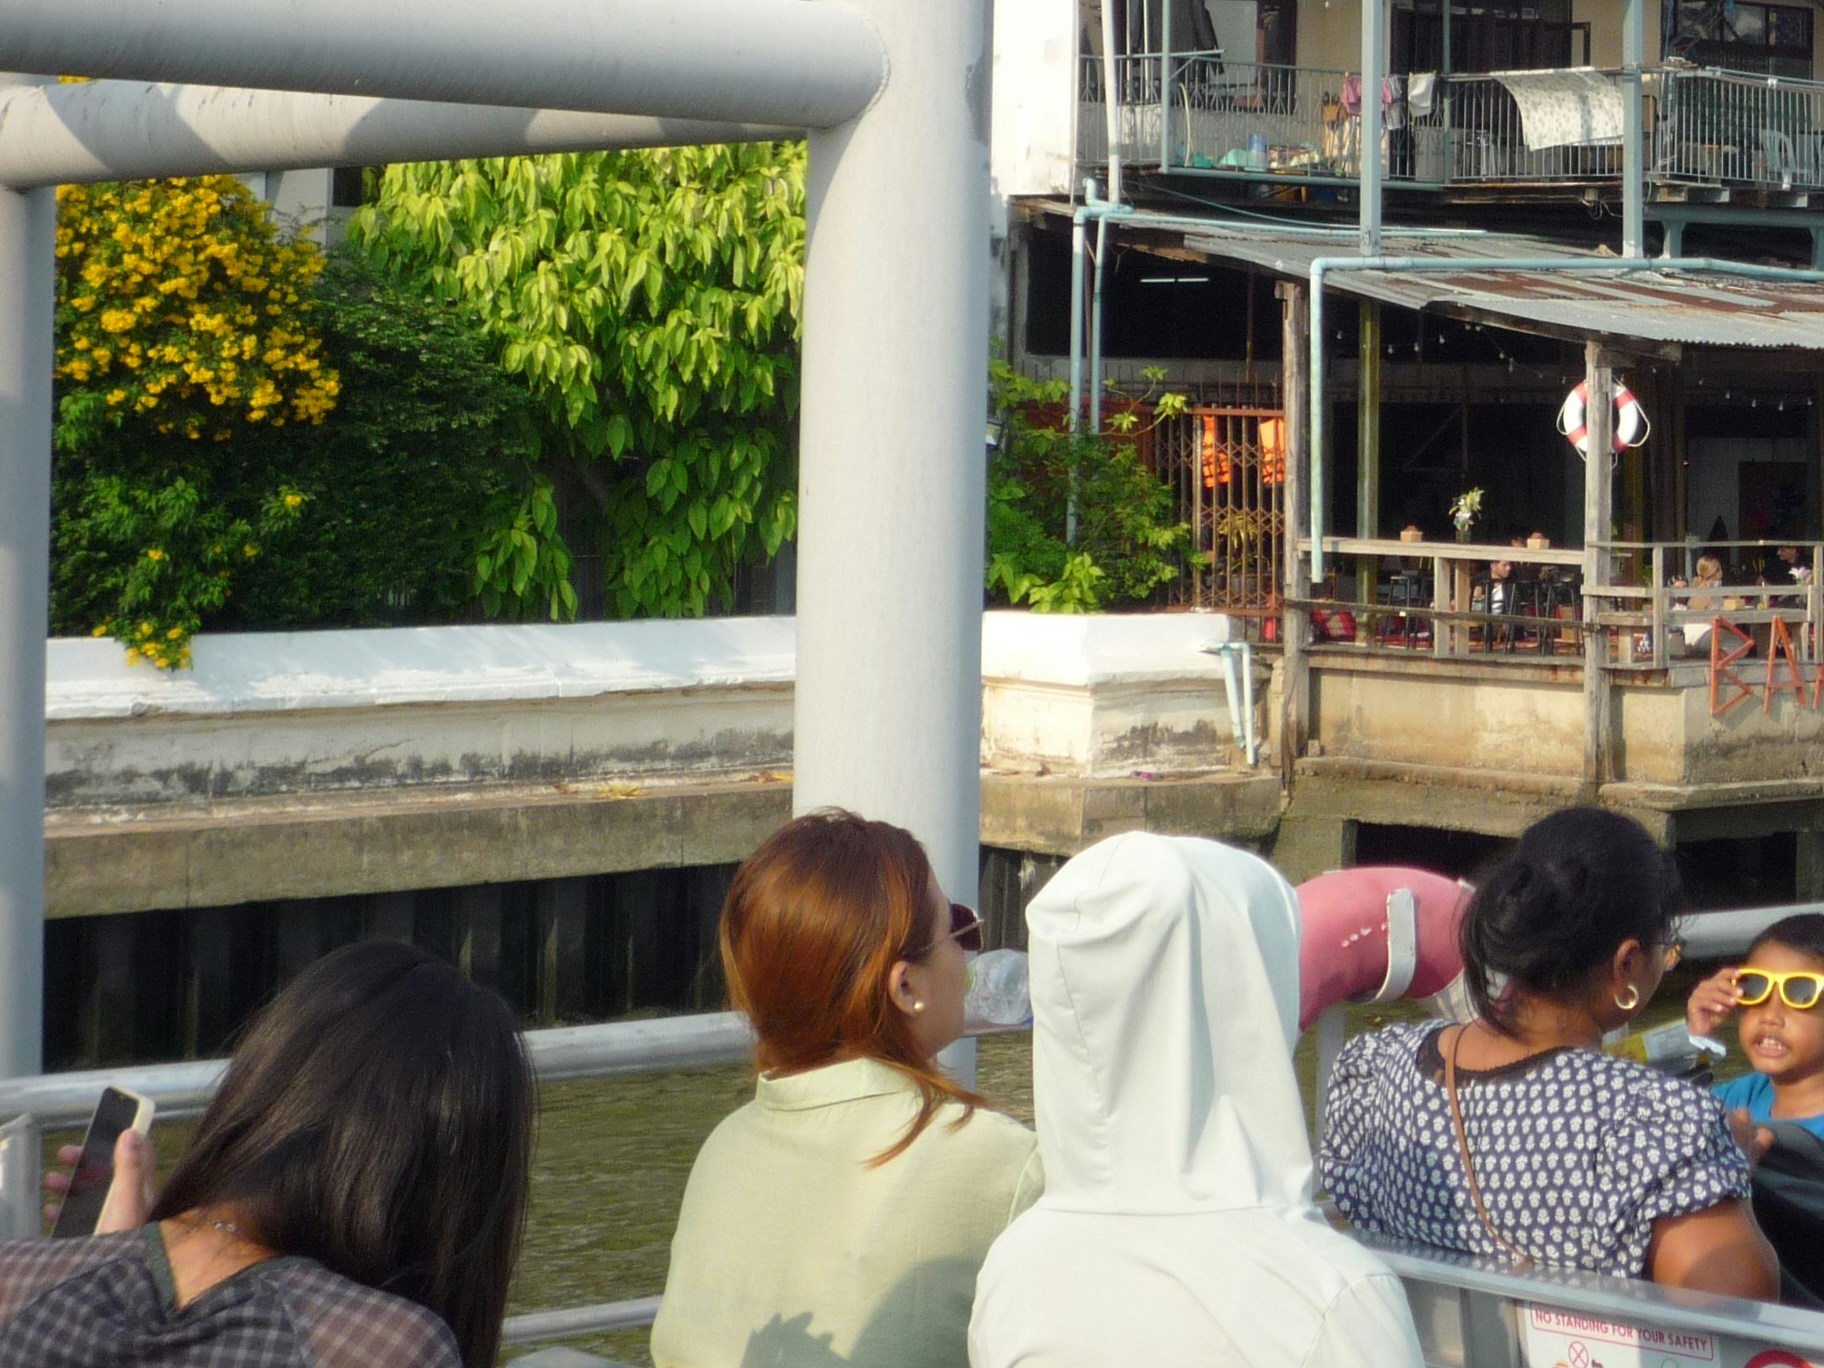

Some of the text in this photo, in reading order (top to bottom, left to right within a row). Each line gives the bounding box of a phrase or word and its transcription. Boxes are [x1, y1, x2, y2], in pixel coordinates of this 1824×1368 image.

[1535, 1310, 1707, 1352] NO STANDING FOR YOUR SAFETY
